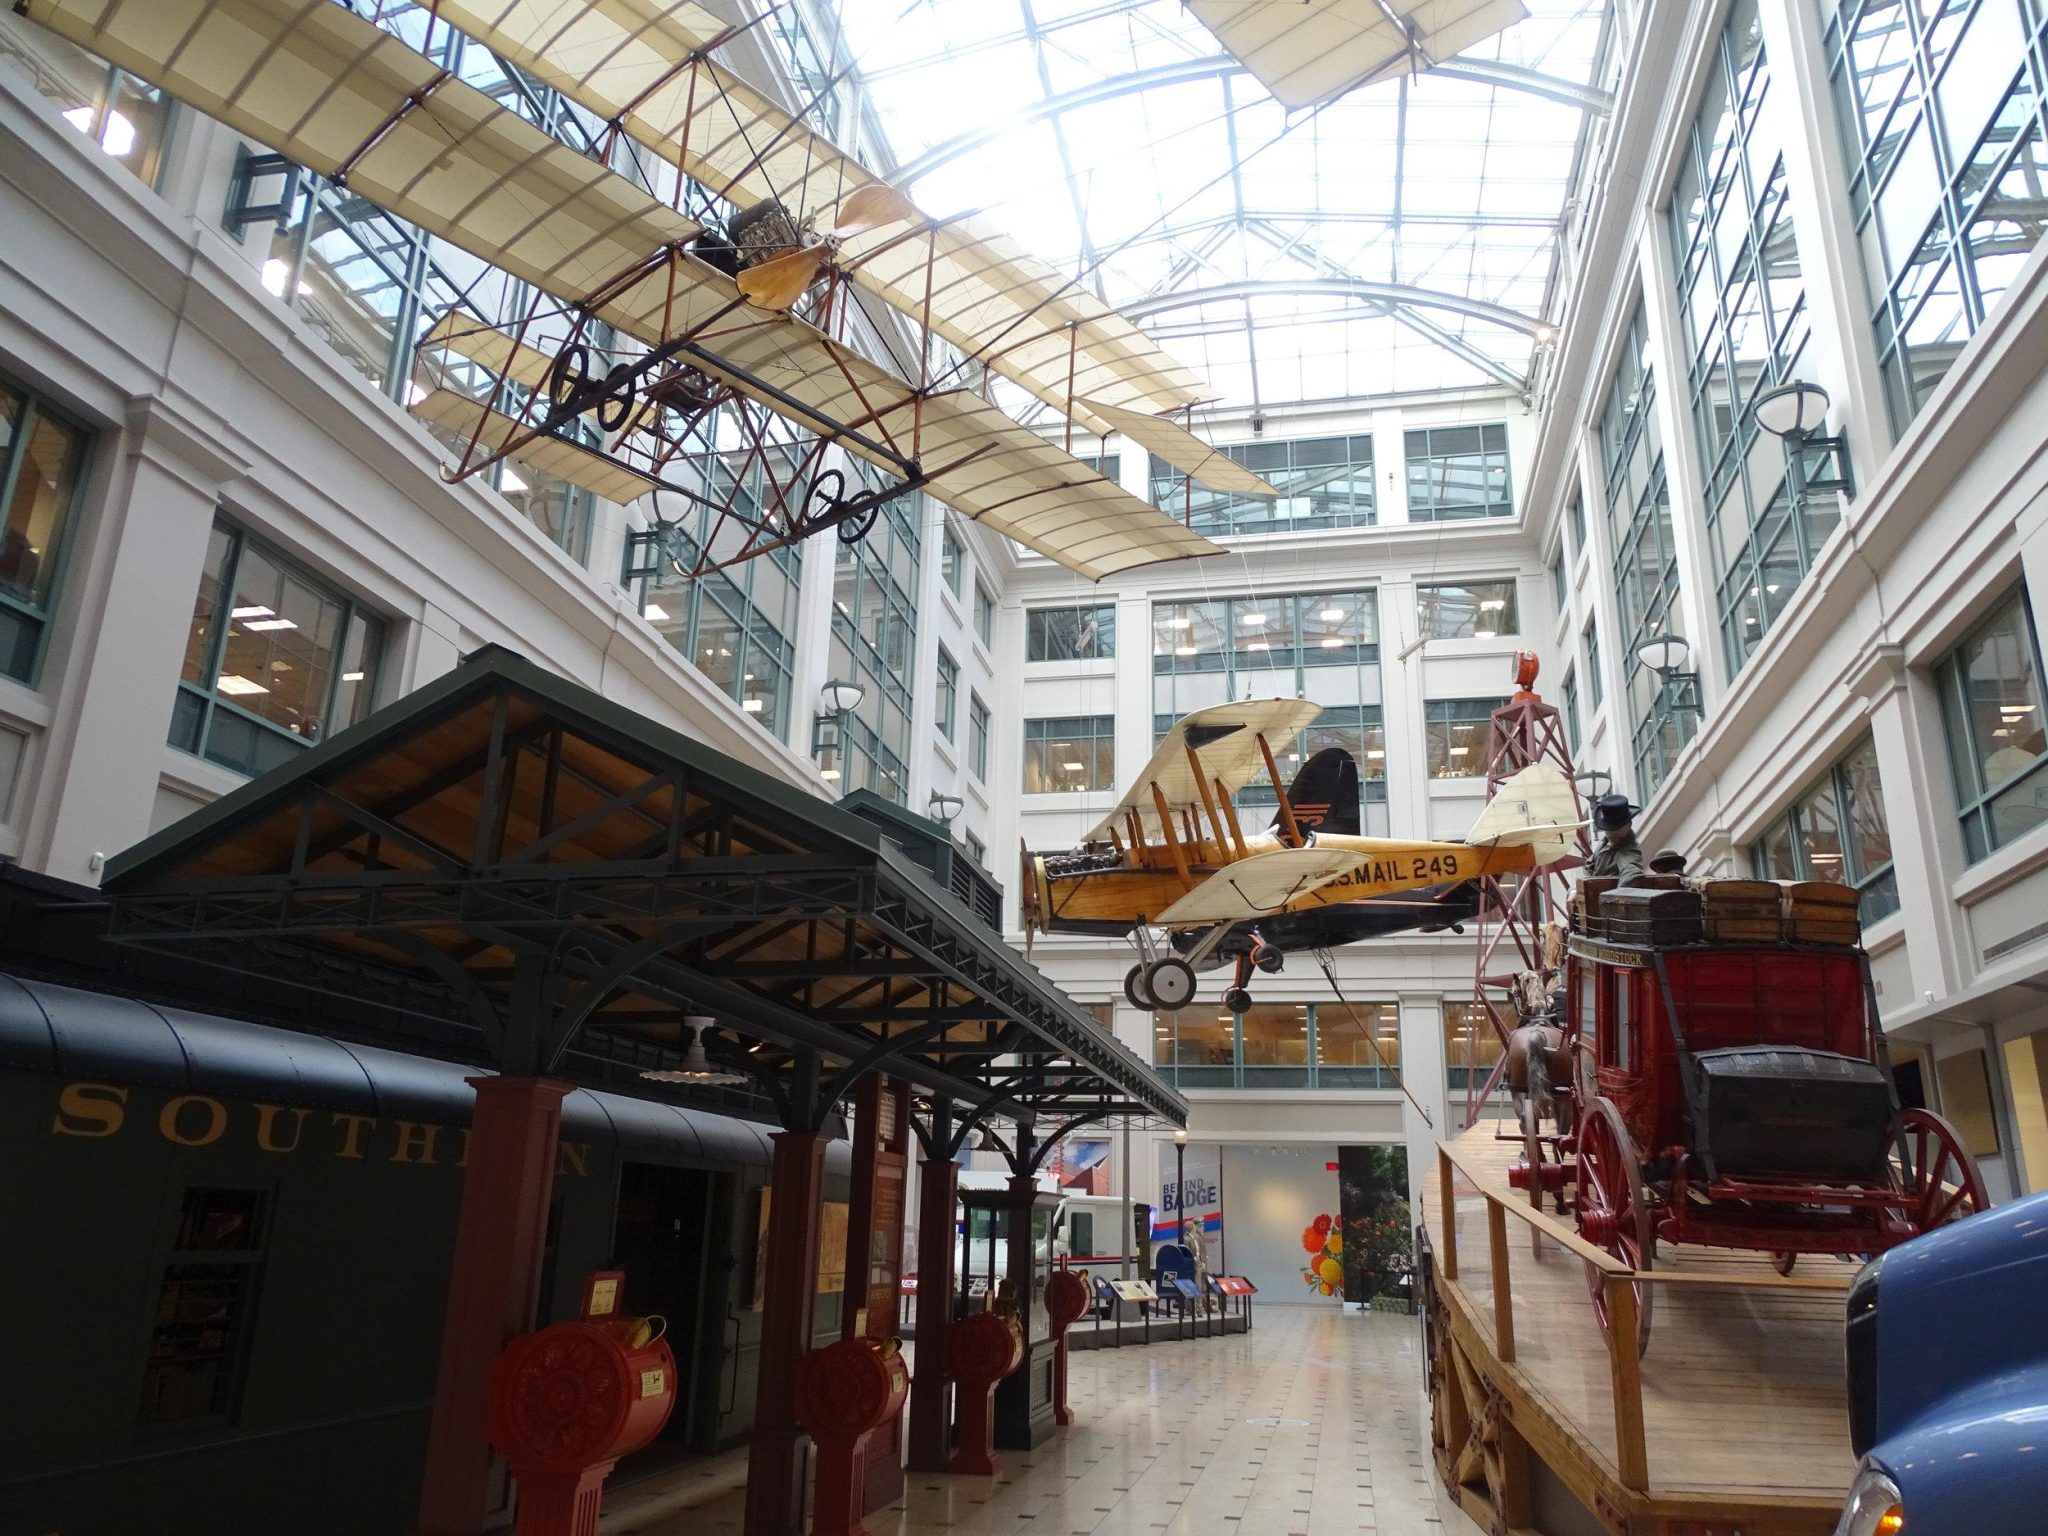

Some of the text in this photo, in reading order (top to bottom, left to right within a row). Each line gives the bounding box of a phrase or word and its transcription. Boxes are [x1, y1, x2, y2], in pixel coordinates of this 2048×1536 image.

[1412, 855, 1458, 879] 249
[52, 1081, 592, 1177] SOUTHN
[1163, 1179, 1204, 1194] BEIND
